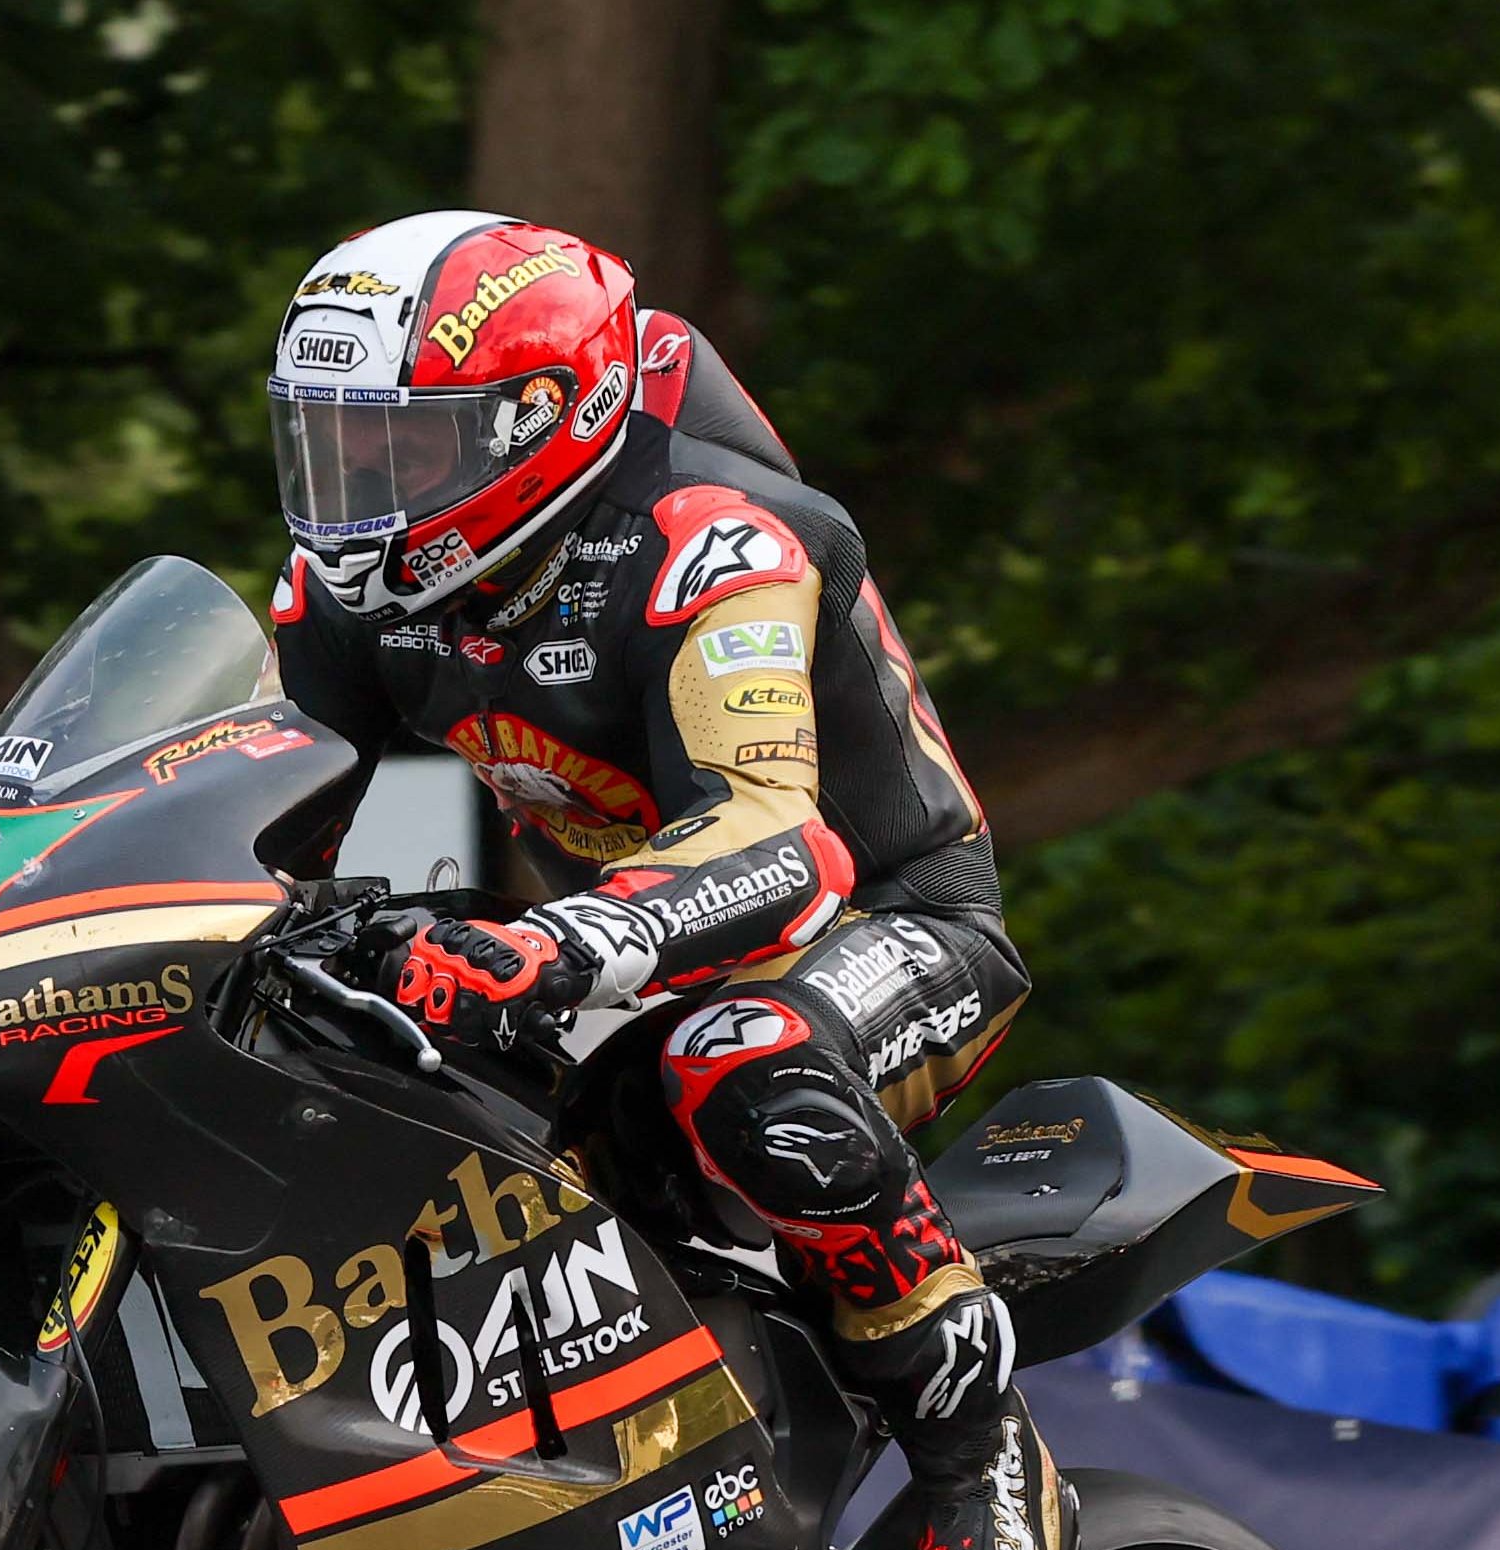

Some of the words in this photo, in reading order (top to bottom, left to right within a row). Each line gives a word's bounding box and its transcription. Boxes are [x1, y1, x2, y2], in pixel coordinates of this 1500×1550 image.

[297, 336, 355, 365] SHOEI
[294, 387, 337, 401] KELTRUCK
[345, 390, 399, 402] KELTRUCK
[582, 371, 623, 432] SHOEI
[513, 403, 554, 442] SHOEI
[408, 532, 463, 571] ebc
[427, 559, 473, 588] group
[684, 896, 766, 936] PRIZEWINNING
[766, 884, 793, 909] ALES
[0, 1006, 167, 1047] RACING
[473, 1216, 640, 1376] AJN
[487, 1304, 651, 1407] STLSTOCK
[704, 1464, 759, 1510] ebc
[622, 1491, 692, 1548] WP
[718, 1506, 764, 1538] group
